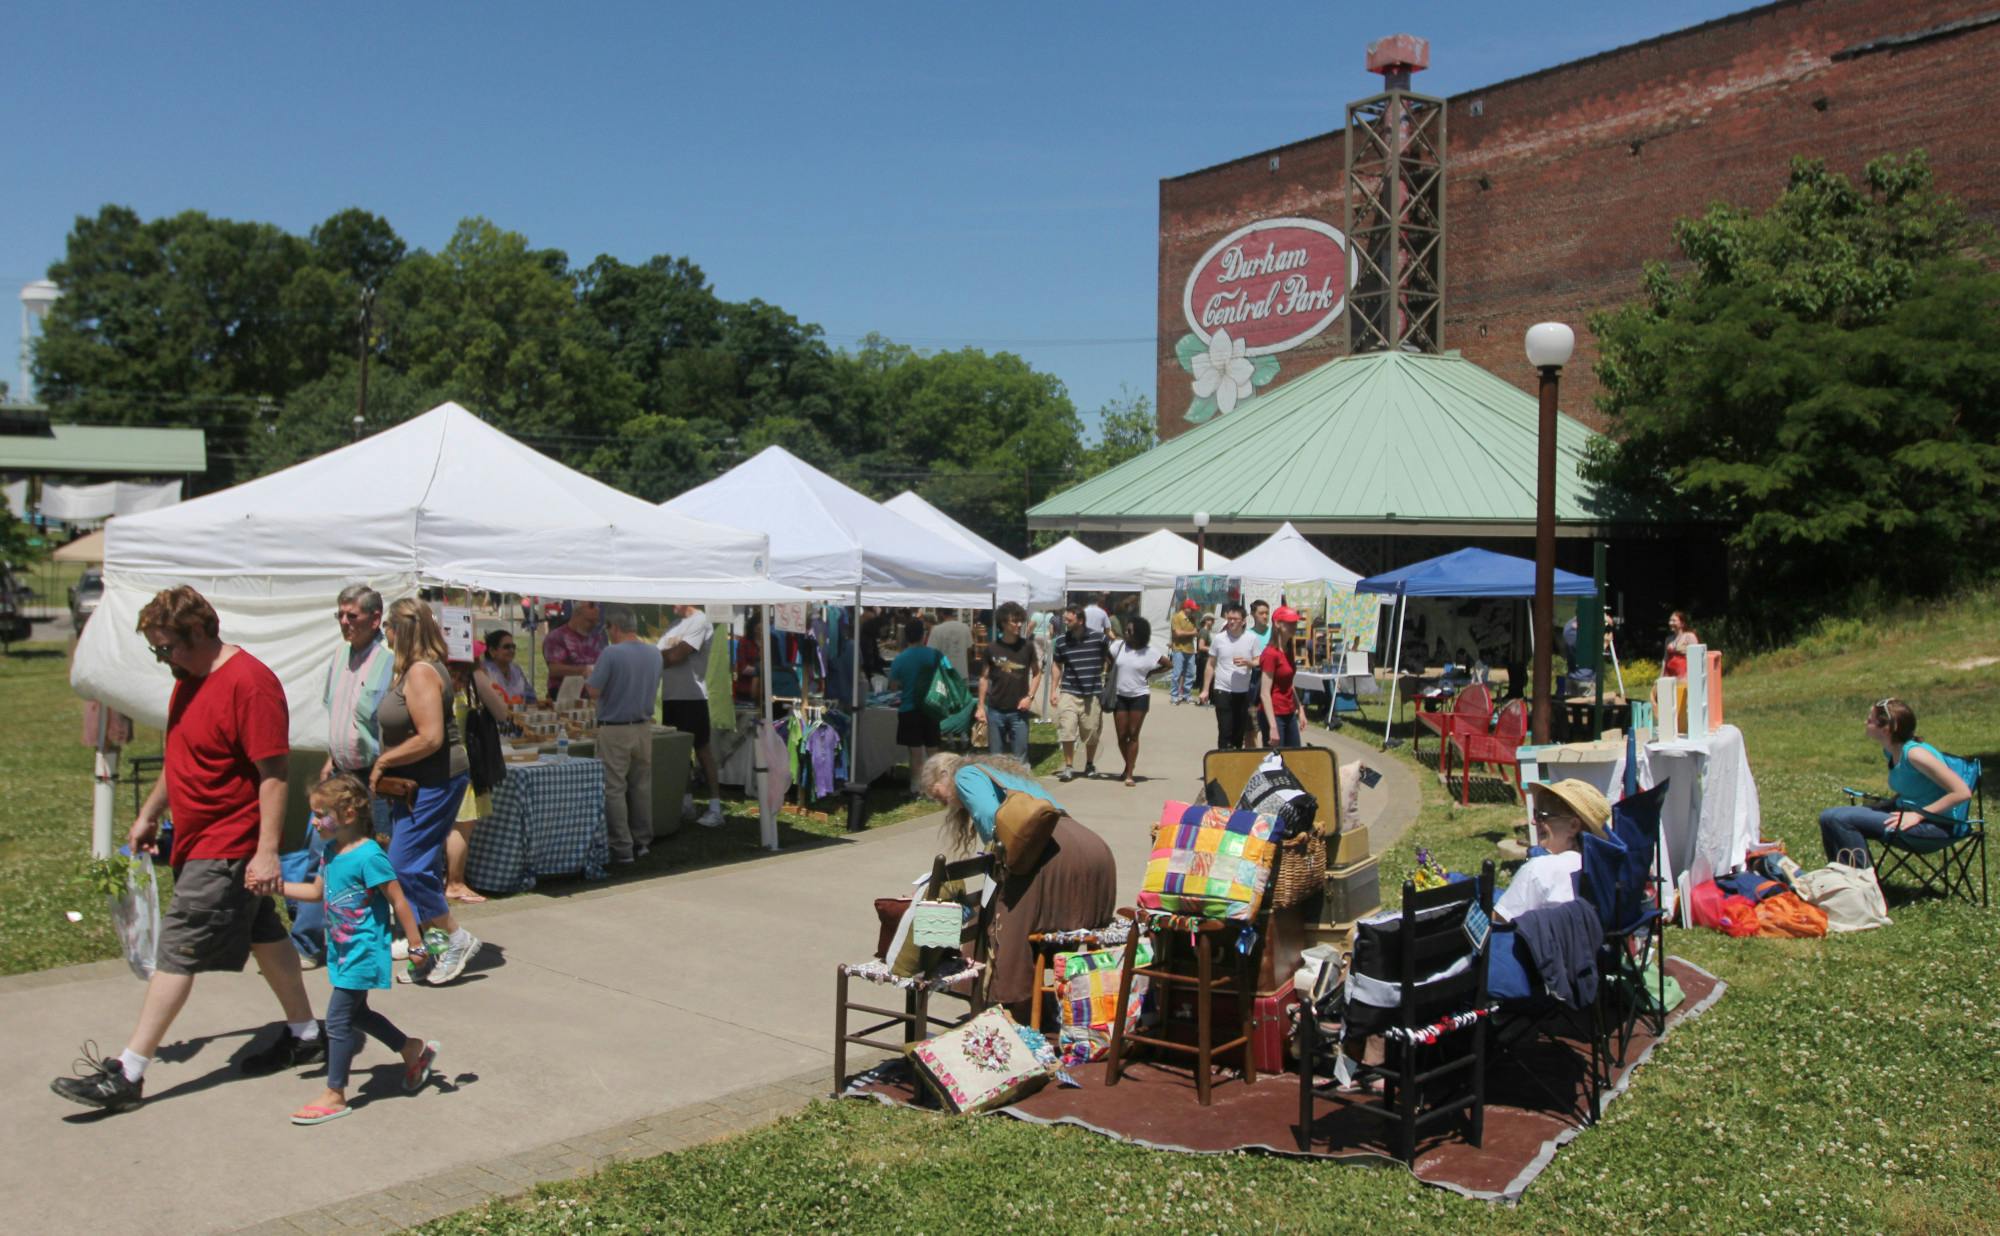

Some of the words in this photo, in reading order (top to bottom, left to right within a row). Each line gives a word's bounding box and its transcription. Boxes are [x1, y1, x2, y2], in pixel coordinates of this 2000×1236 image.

[1217, 242, 1308, 283] Durham
[1203, 280, 1280, 328] Central
[1277, 274, 1333, 315] Park
